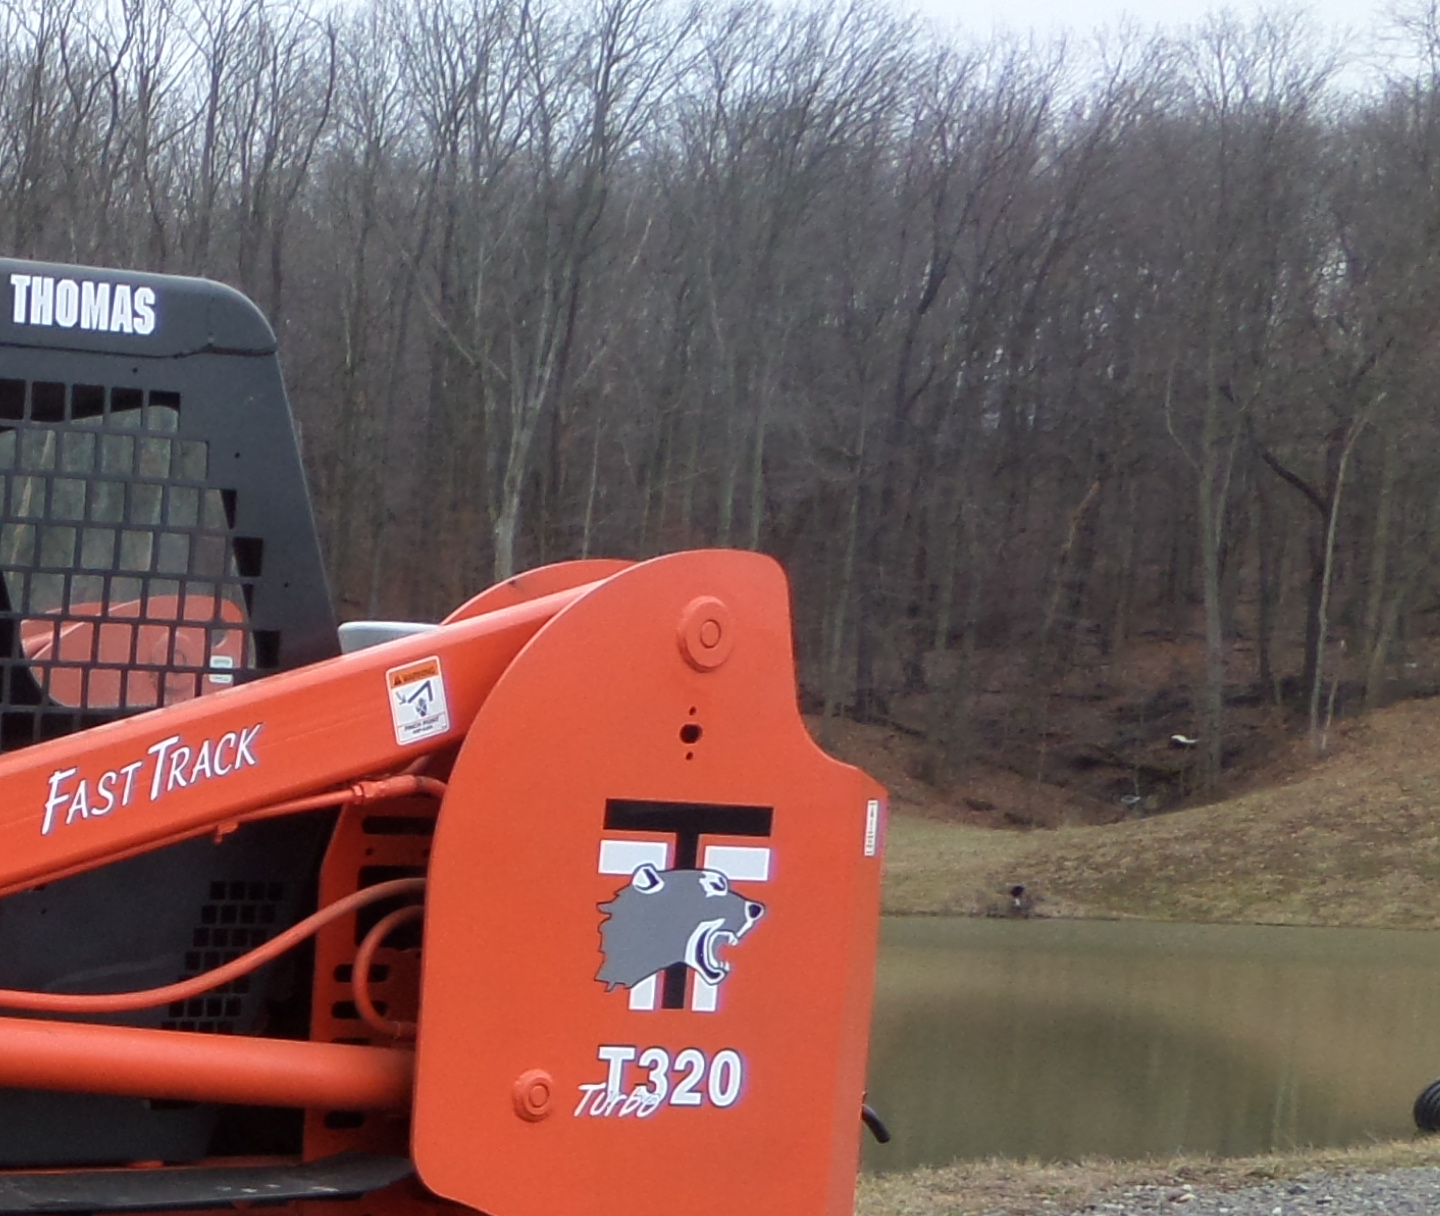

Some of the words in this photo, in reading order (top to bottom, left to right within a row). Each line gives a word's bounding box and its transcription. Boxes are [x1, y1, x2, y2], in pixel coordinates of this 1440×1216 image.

[10, 274, 156, 335] THOMAS
[40, 767, 143, 835] FAST
[148, 722, 263, 801] TRACK
[573, 1082, 660, 1118] Turbo
[598, 1045, 742, 1107] T320
